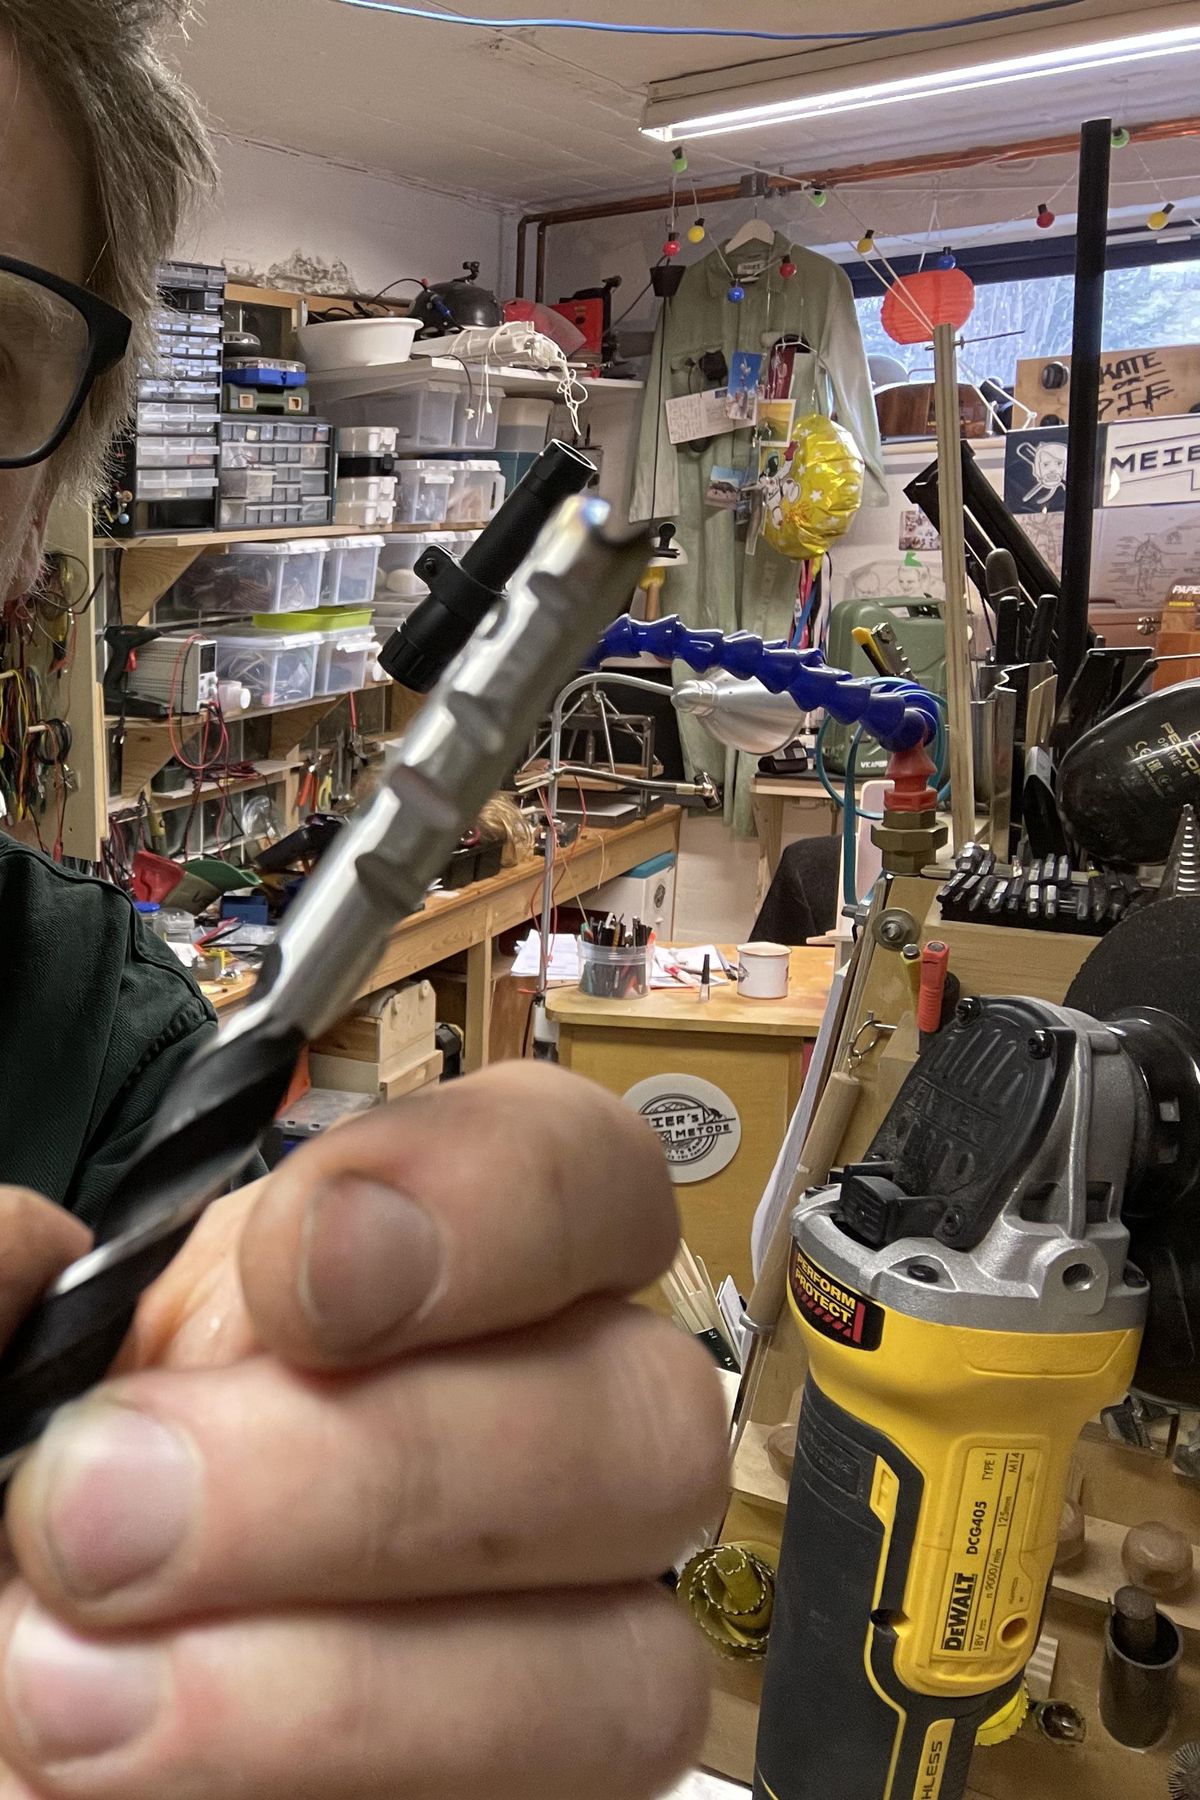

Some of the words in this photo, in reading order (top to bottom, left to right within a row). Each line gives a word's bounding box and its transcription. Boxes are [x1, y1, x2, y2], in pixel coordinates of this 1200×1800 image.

[1100, 352, 1161, 385] KATE
[1158, 737, 1181, 767] OPIME
[651, 1113, 699, 1128] IER'S
[676, 1124, 730, 1139] METODE
[795, 1268, 852, 1323] PROTECT
[797, 1252, 855, 1309] PERFORM
[966, 1501, 987, 1555] DCG405
[982, 1460, 996, 1480] TYPE
